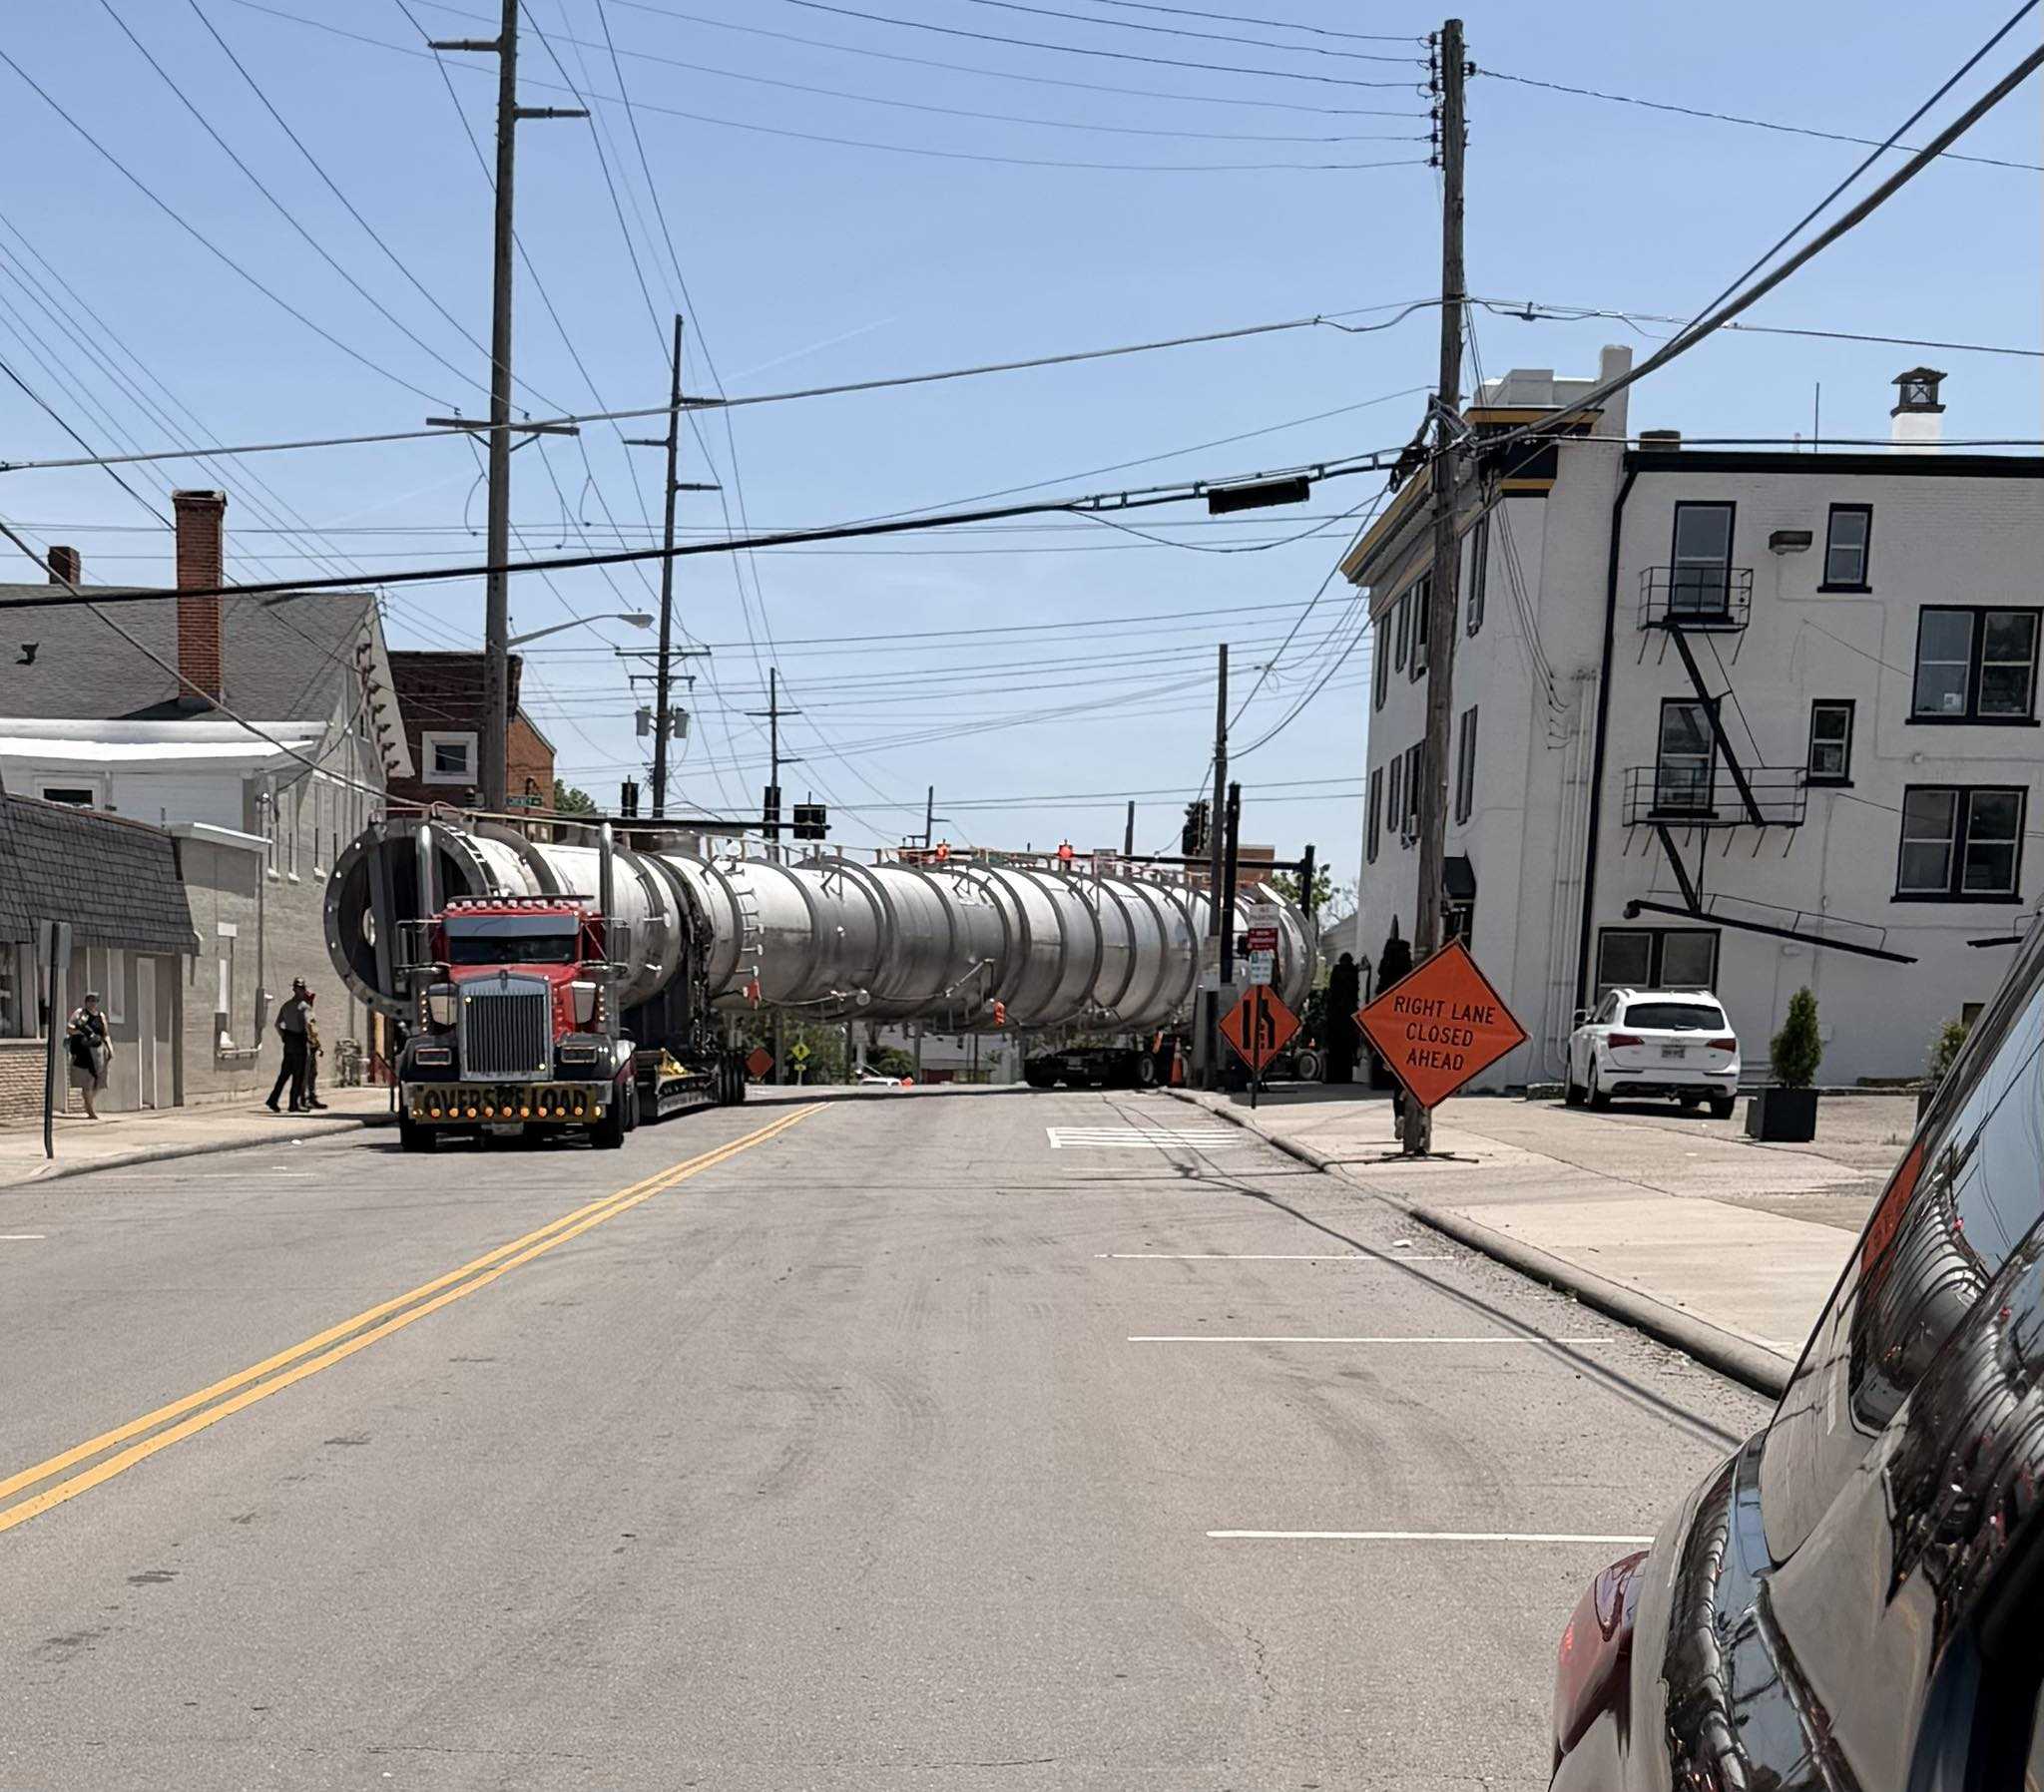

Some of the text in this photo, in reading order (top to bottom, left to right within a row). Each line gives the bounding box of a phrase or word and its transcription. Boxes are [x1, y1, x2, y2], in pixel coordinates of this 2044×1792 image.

[1394, 996, 1496, 1025] RIGHT LANE
[1406, 1022, 1473, 1047] CLOSED
[1405, 1048, 1464, 1071] AHEAD
